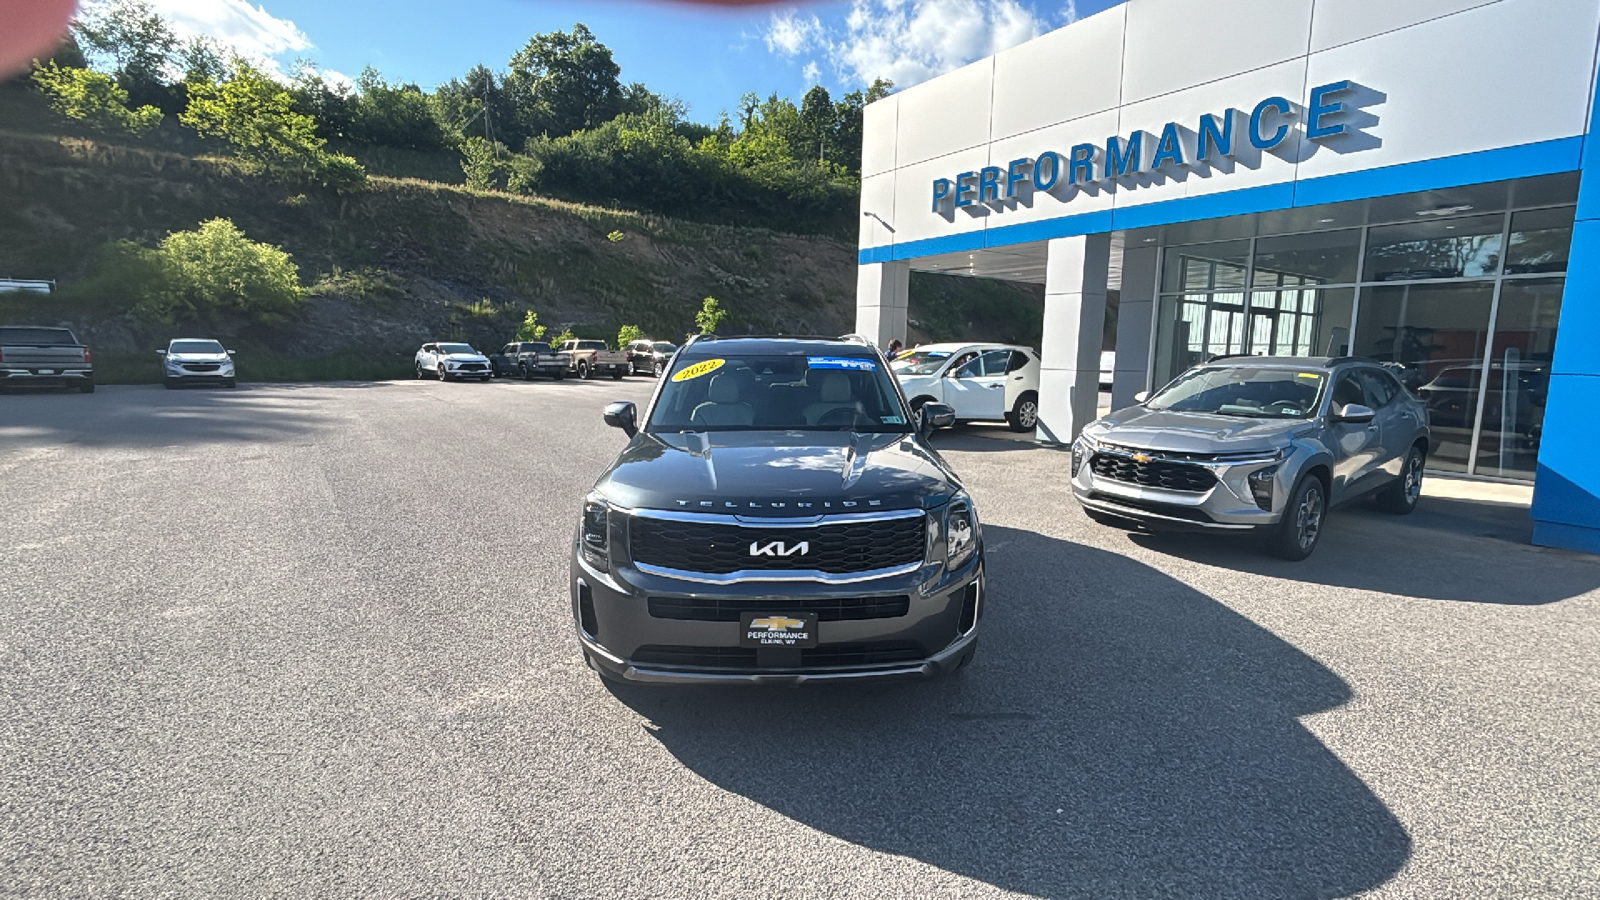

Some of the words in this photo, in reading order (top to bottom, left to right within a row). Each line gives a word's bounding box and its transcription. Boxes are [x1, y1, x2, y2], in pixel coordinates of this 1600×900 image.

[931, 79, 1351, 214] PERFORMANCE
[682, 361, 717, 379] 2022
[676, 499, 881, 507] TELLURIDE
[749, 541, 808, 556] KIA
[747, 631, 809, 639] PERFORMANCE
